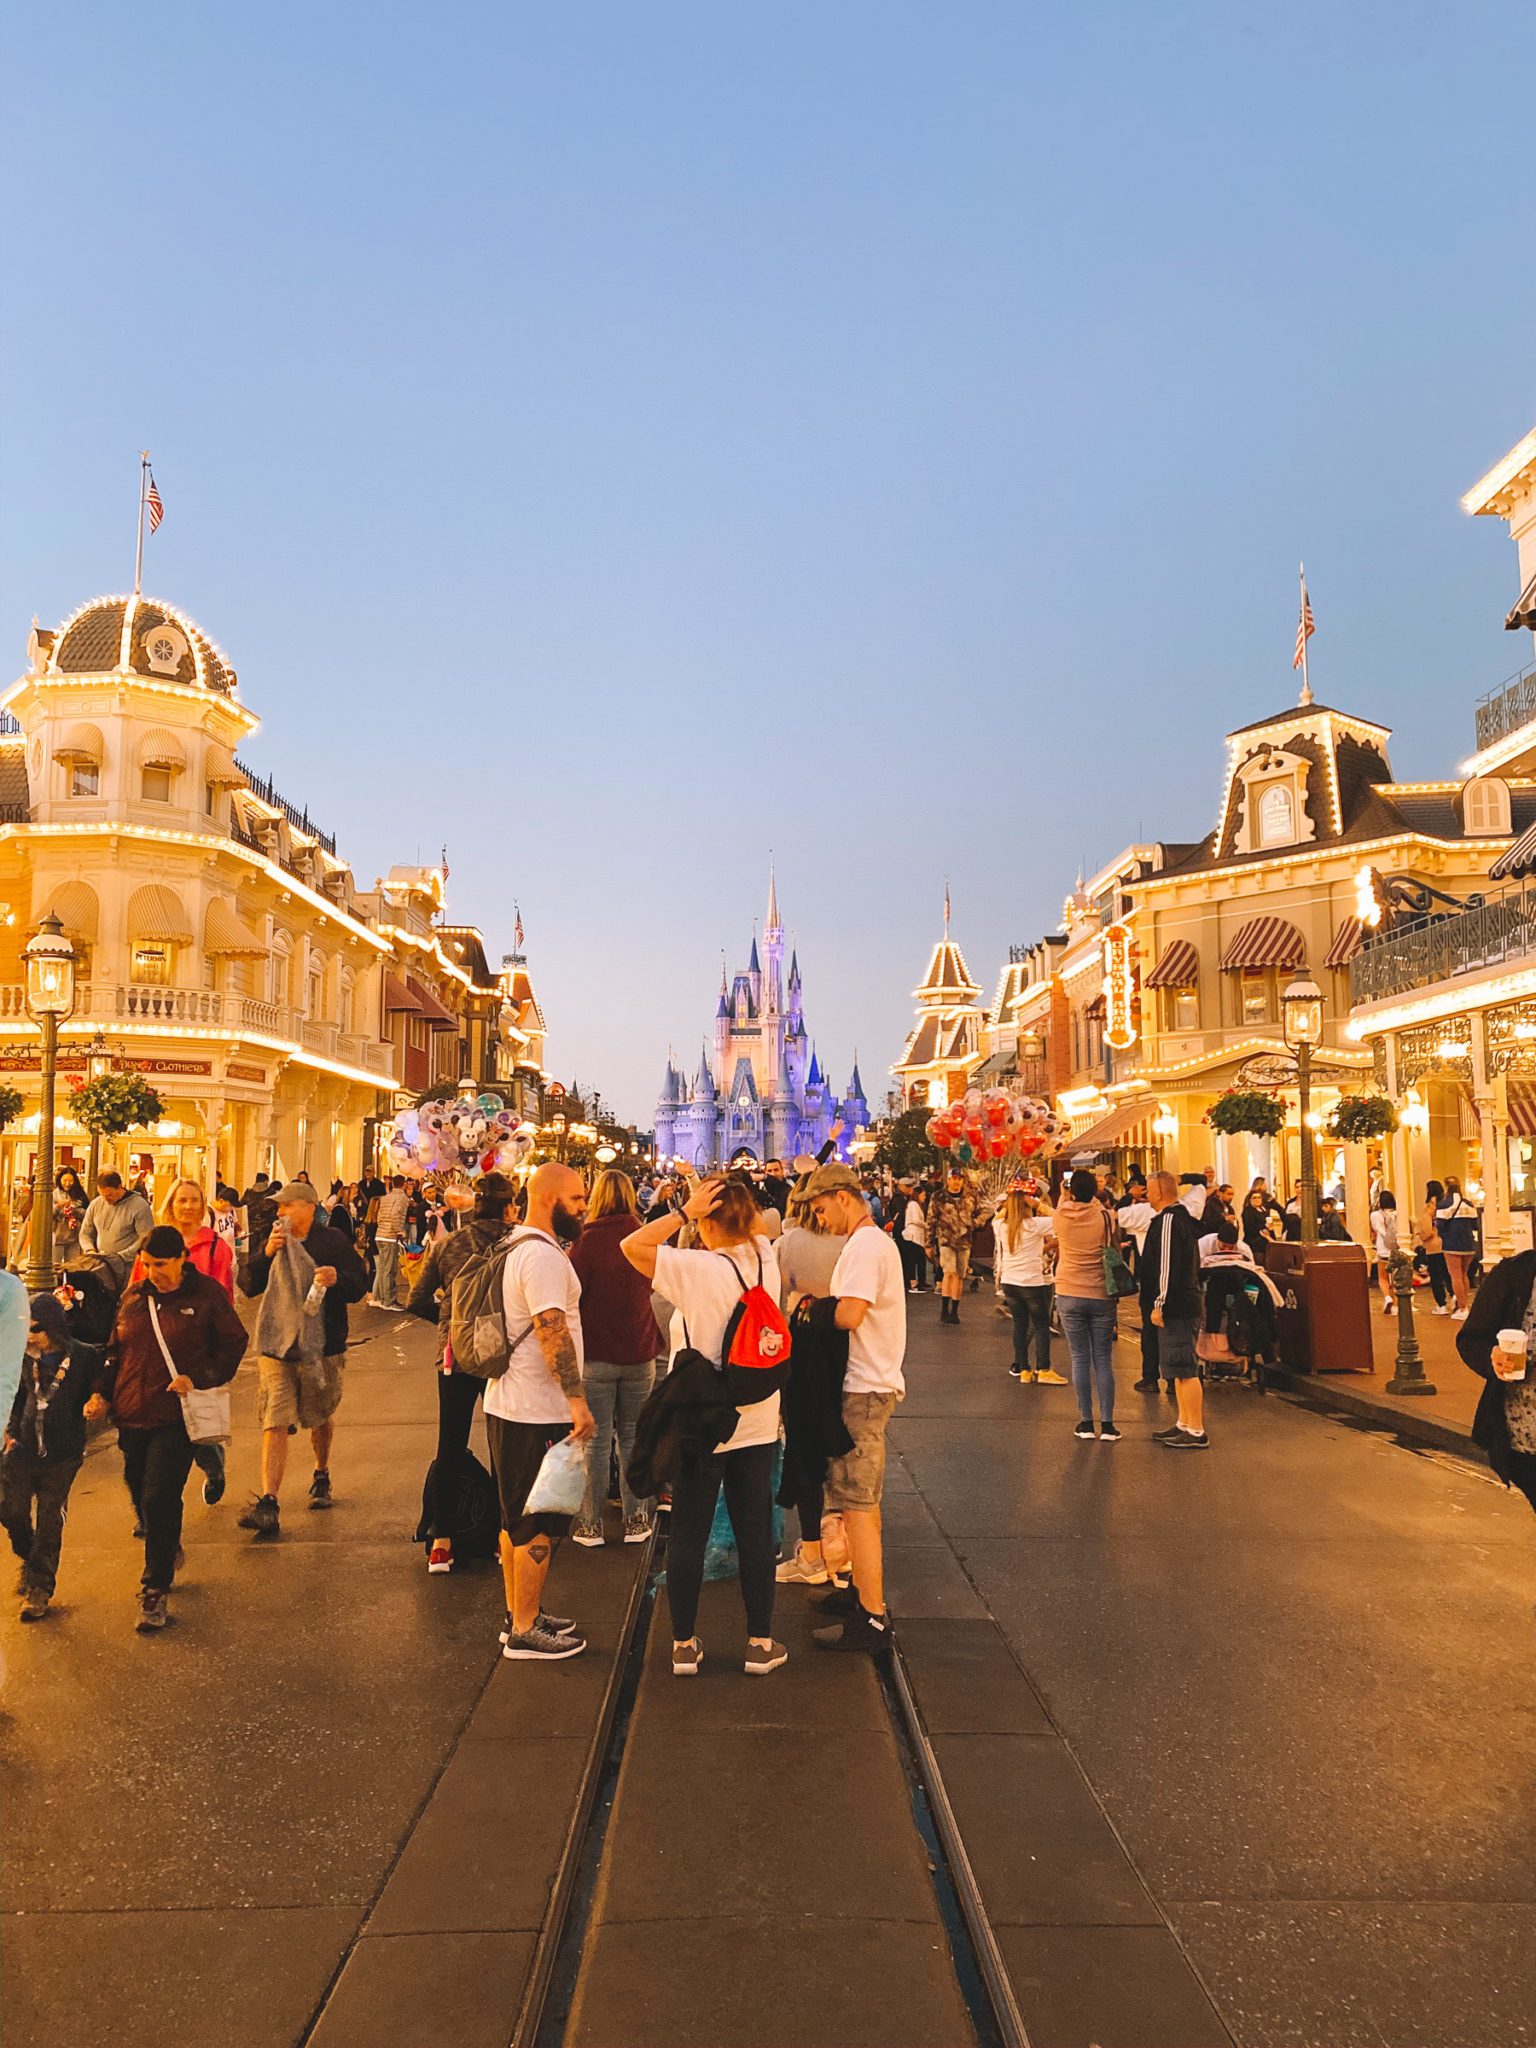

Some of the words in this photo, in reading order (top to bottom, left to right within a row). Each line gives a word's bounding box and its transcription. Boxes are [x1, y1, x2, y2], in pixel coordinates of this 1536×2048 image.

[1112, 941, 1124, 993] CRYSTAL
[1113, 1000, 1125, 1031] ARTS
[218, 1215, 234, 1233] GAP
